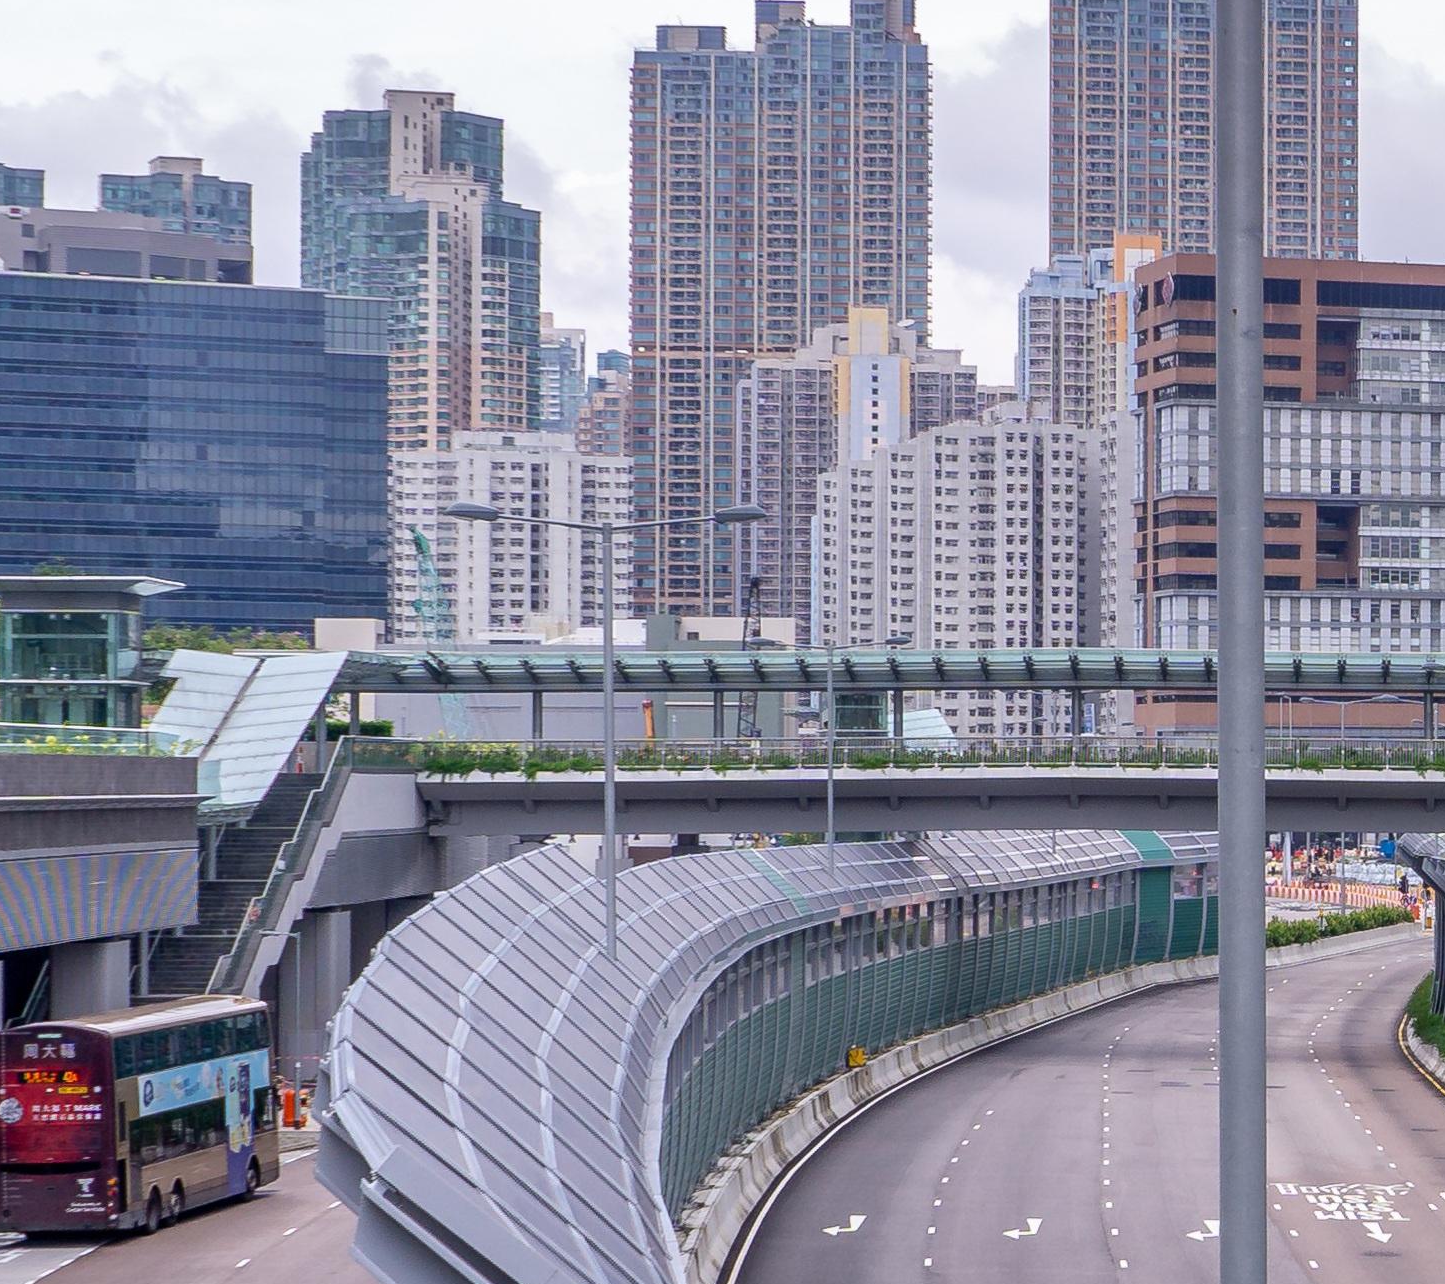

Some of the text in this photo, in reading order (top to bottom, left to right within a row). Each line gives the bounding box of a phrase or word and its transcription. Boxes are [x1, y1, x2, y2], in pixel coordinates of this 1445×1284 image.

[1305, 1194, 1394, 1204] TSUI
[1316, 1202, 1394, 1212] SHA
[1314, 1211, 1410, 1221] TSIM
